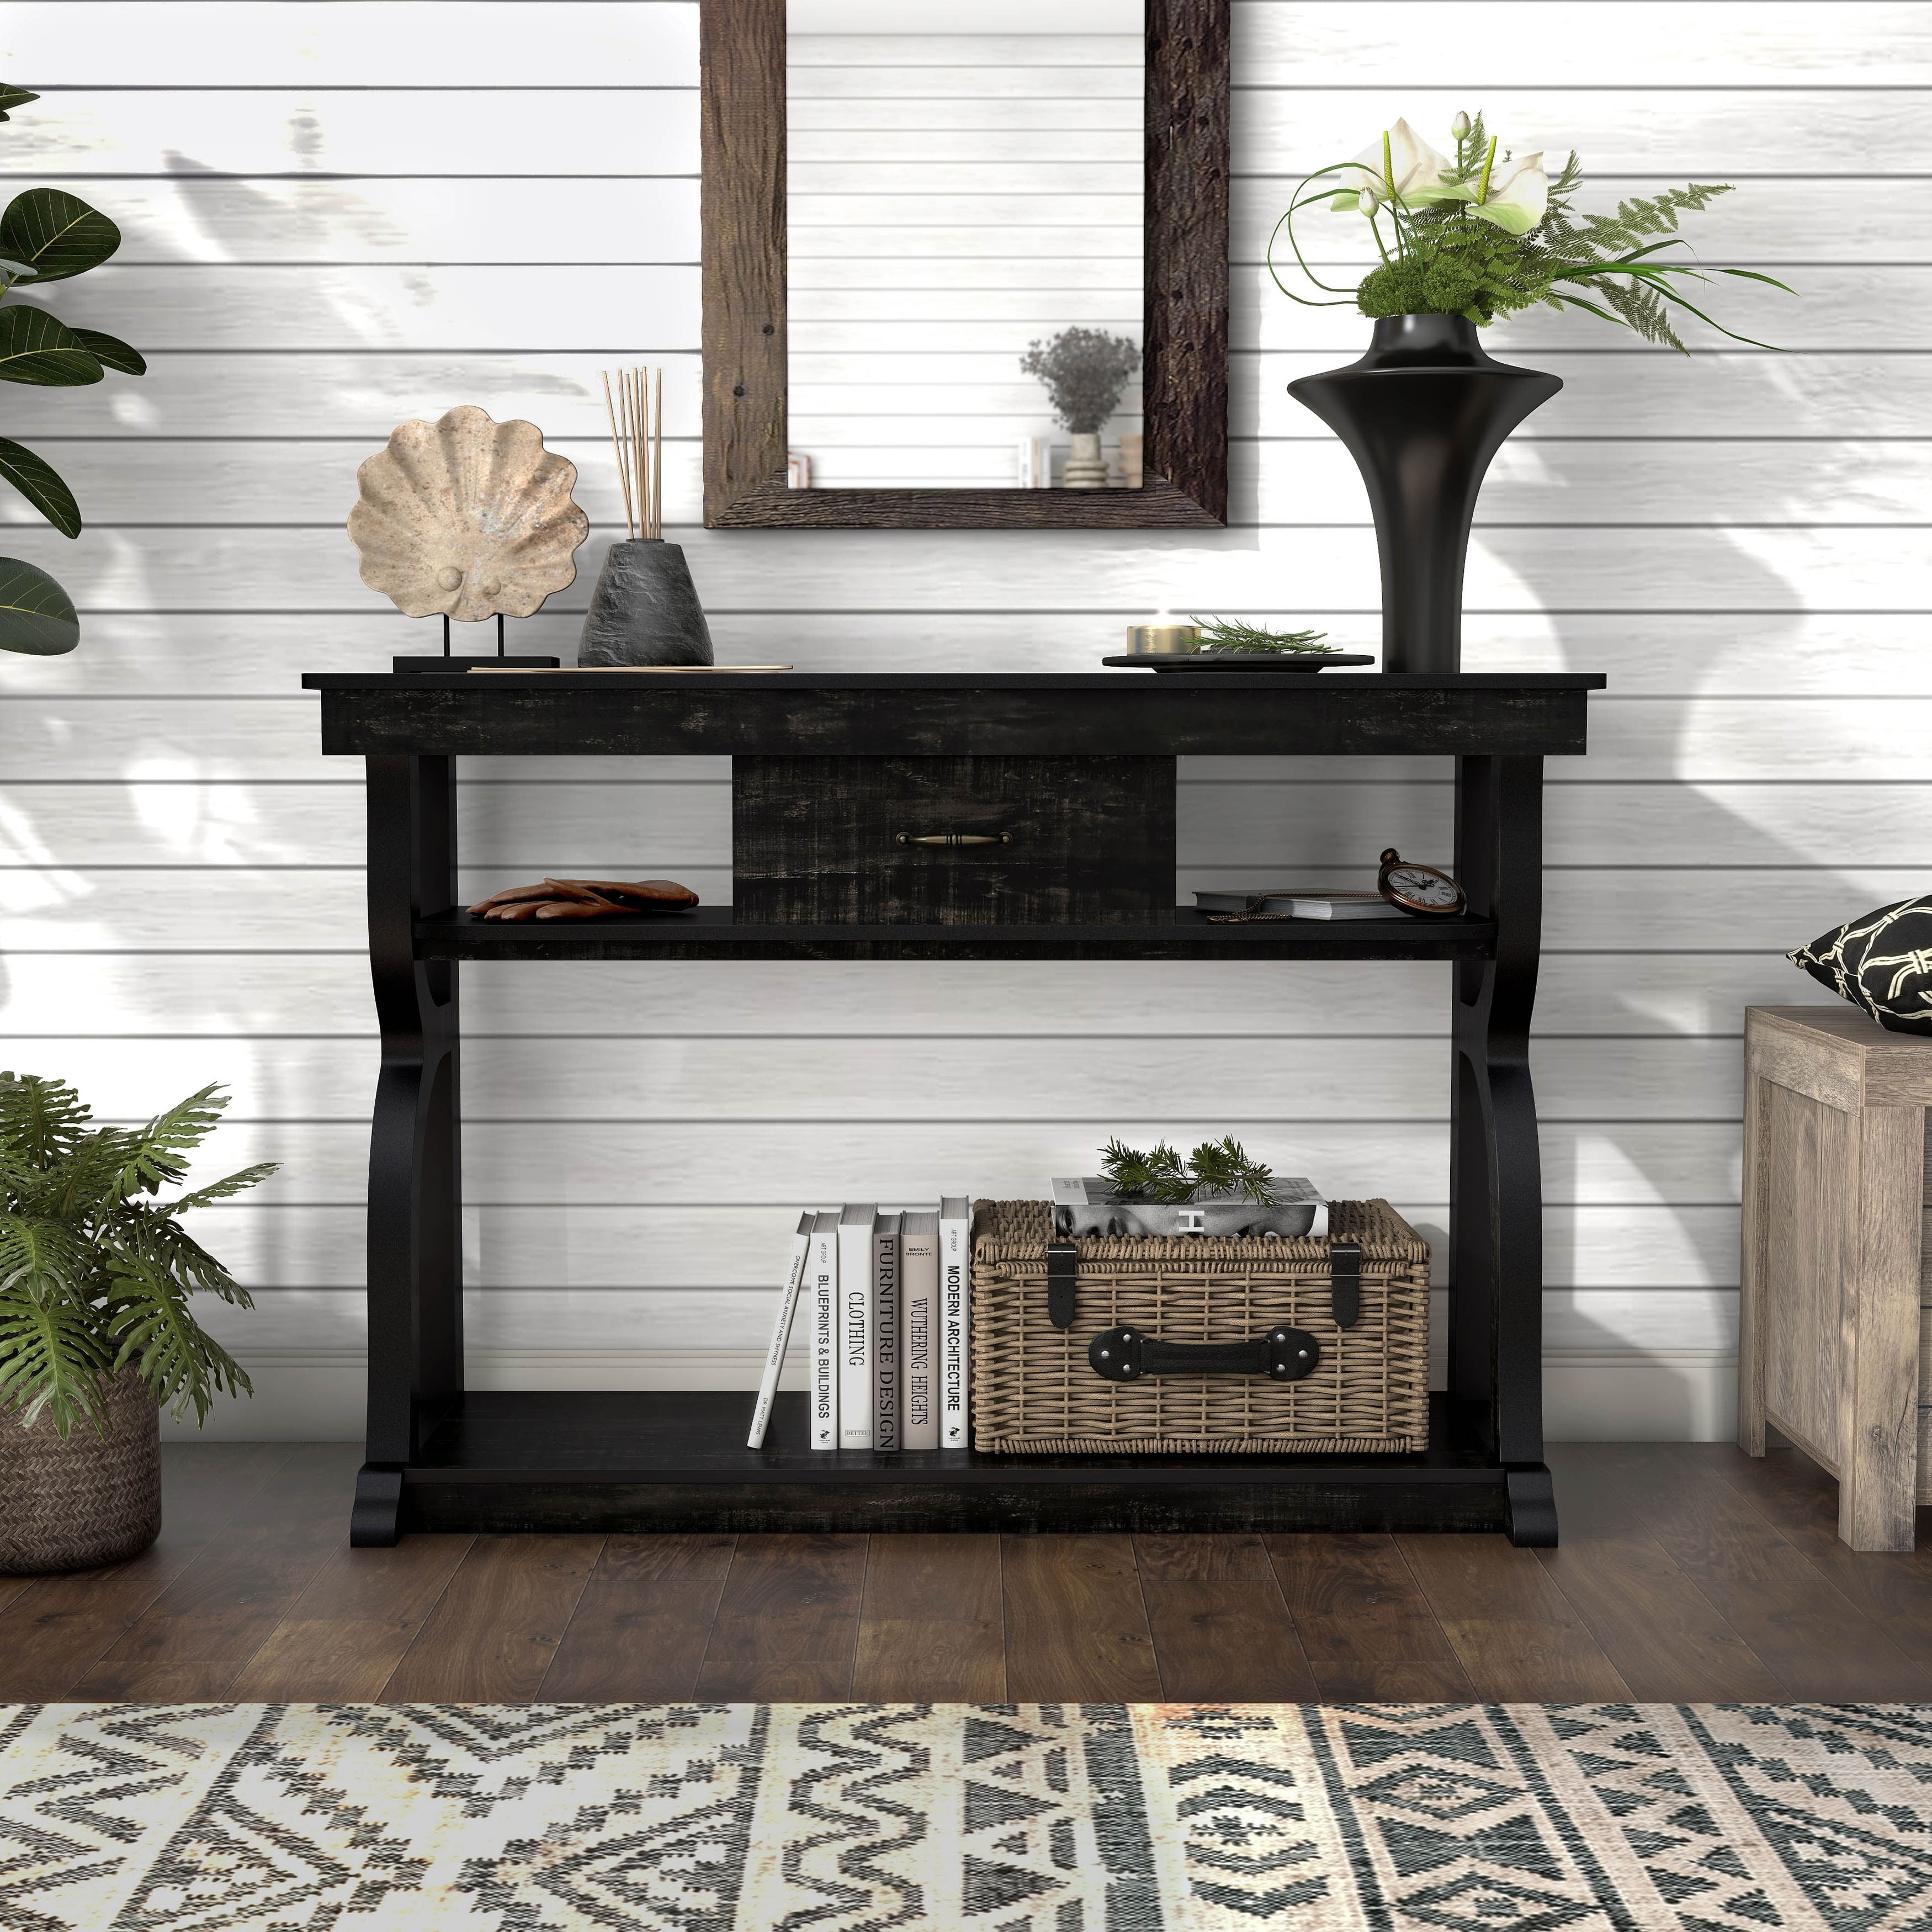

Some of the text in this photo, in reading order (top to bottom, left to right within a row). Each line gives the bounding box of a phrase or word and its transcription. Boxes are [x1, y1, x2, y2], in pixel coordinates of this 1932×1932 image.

[785, 1286, 794, 1304] SOCIAL
[789, 1255, 800, 1285] OVERCOME
[779, 1305, 789, 1329] ANXIETY
[818, 1275, 829, 1344] BLUEPRINTS
[848, 1292, 864, 1366] CLOTHING
[947, 1266, 960, 1411] MODERN ARCHITECTURE
[771, 1343, 781, 1366] SHYNESS
[879, 1239, 894, 1449] FURNITURE DESIGN
[911, 1297, 928, 1425] WUTHERING HEIGHTS
[818, 1359, 830, 1419] BUILDINGS
